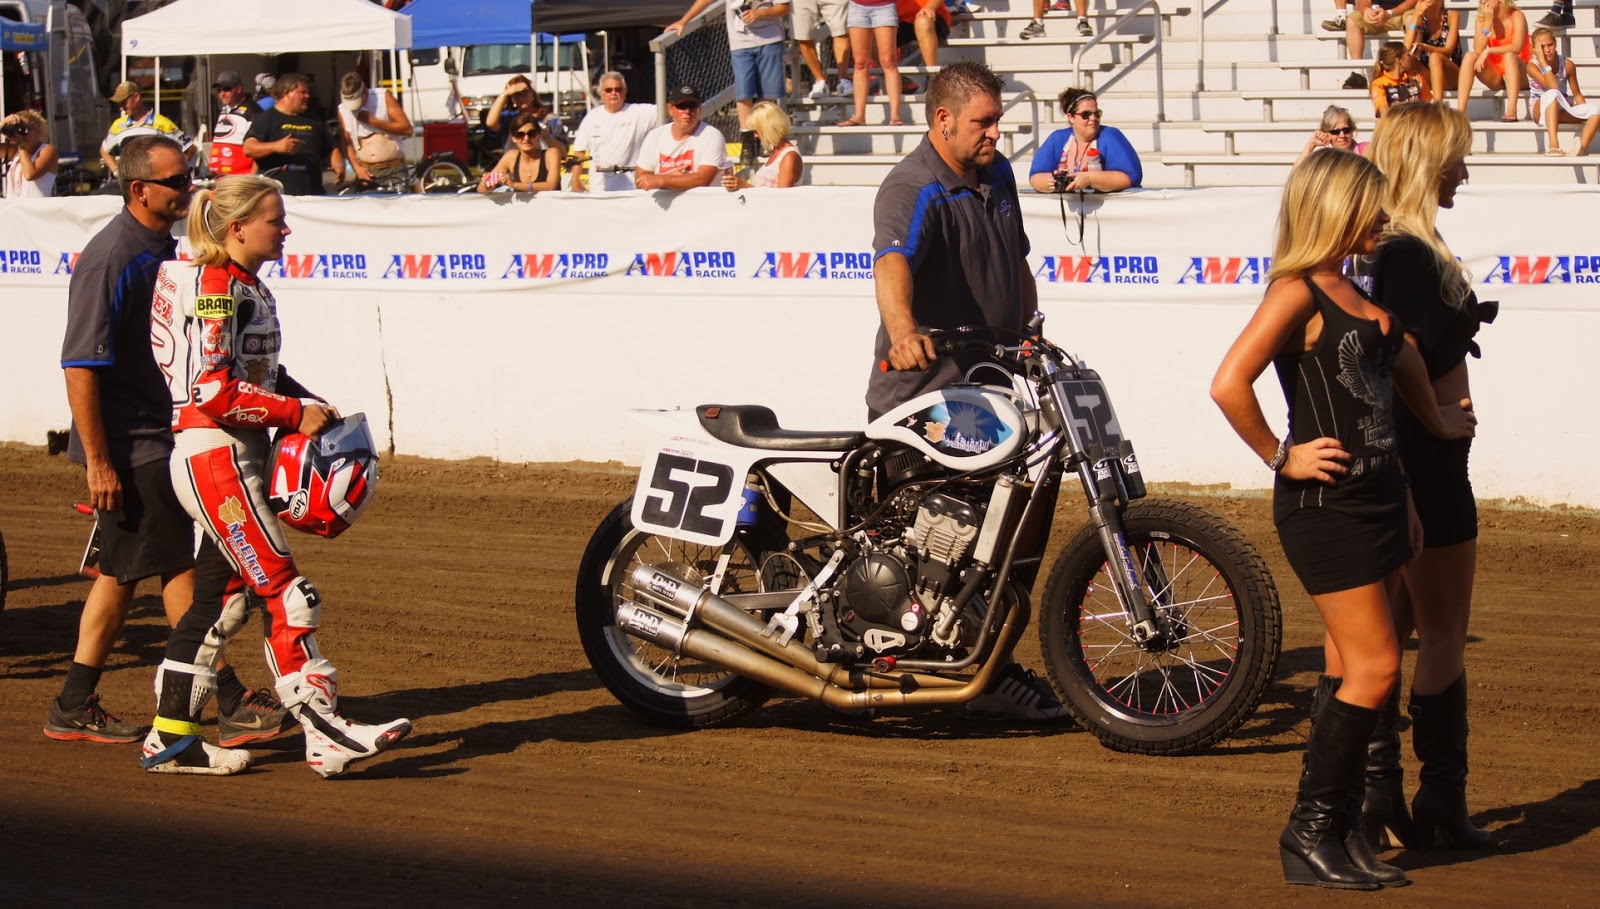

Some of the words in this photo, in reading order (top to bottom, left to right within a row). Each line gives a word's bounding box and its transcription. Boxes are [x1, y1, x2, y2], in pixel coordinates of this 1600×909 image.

[10, 251, 41, 265] PRO
[265, 254, 329, 279] AMA
[331, 254, 367, 270] PRO
[382, 254, 447, 279] AMA
[450, 254, 486, 270] PRO
[500, 254, 569, 279] AMA
[572, 253, 609, 269] PRO
[625, 252, 692, 277] AMA
[694, 251, 736, 268] PRO
[752, 252, 828, 279] AMA
[830, 252, 872, 269] PRO
[1035, 256, 1111, 283] AMA
[1114, 256, 1159, 273] PRO
[1176, 257, 1260, 284] AMA
[1483, 255, 1571, 284] AMA
[1573, 255, 1600, 273] PR
[332, 271, 368, 279] RACING
[451, 271, 487, 279] RACING
[570, 271, 609, 279] RACING
[695, 270, 737, 278] RACING
[831, 271, 873, 280] RACING
[1115, 275, 1160, 284] RACING
[1575, 275, 1600, 284] RAC
[222, 404, 269, 424] Apex
[1062, 381, 1122, 454] 52
[641, 451, 734, 538] 52
[226, 521, 271, 587] McElroy
